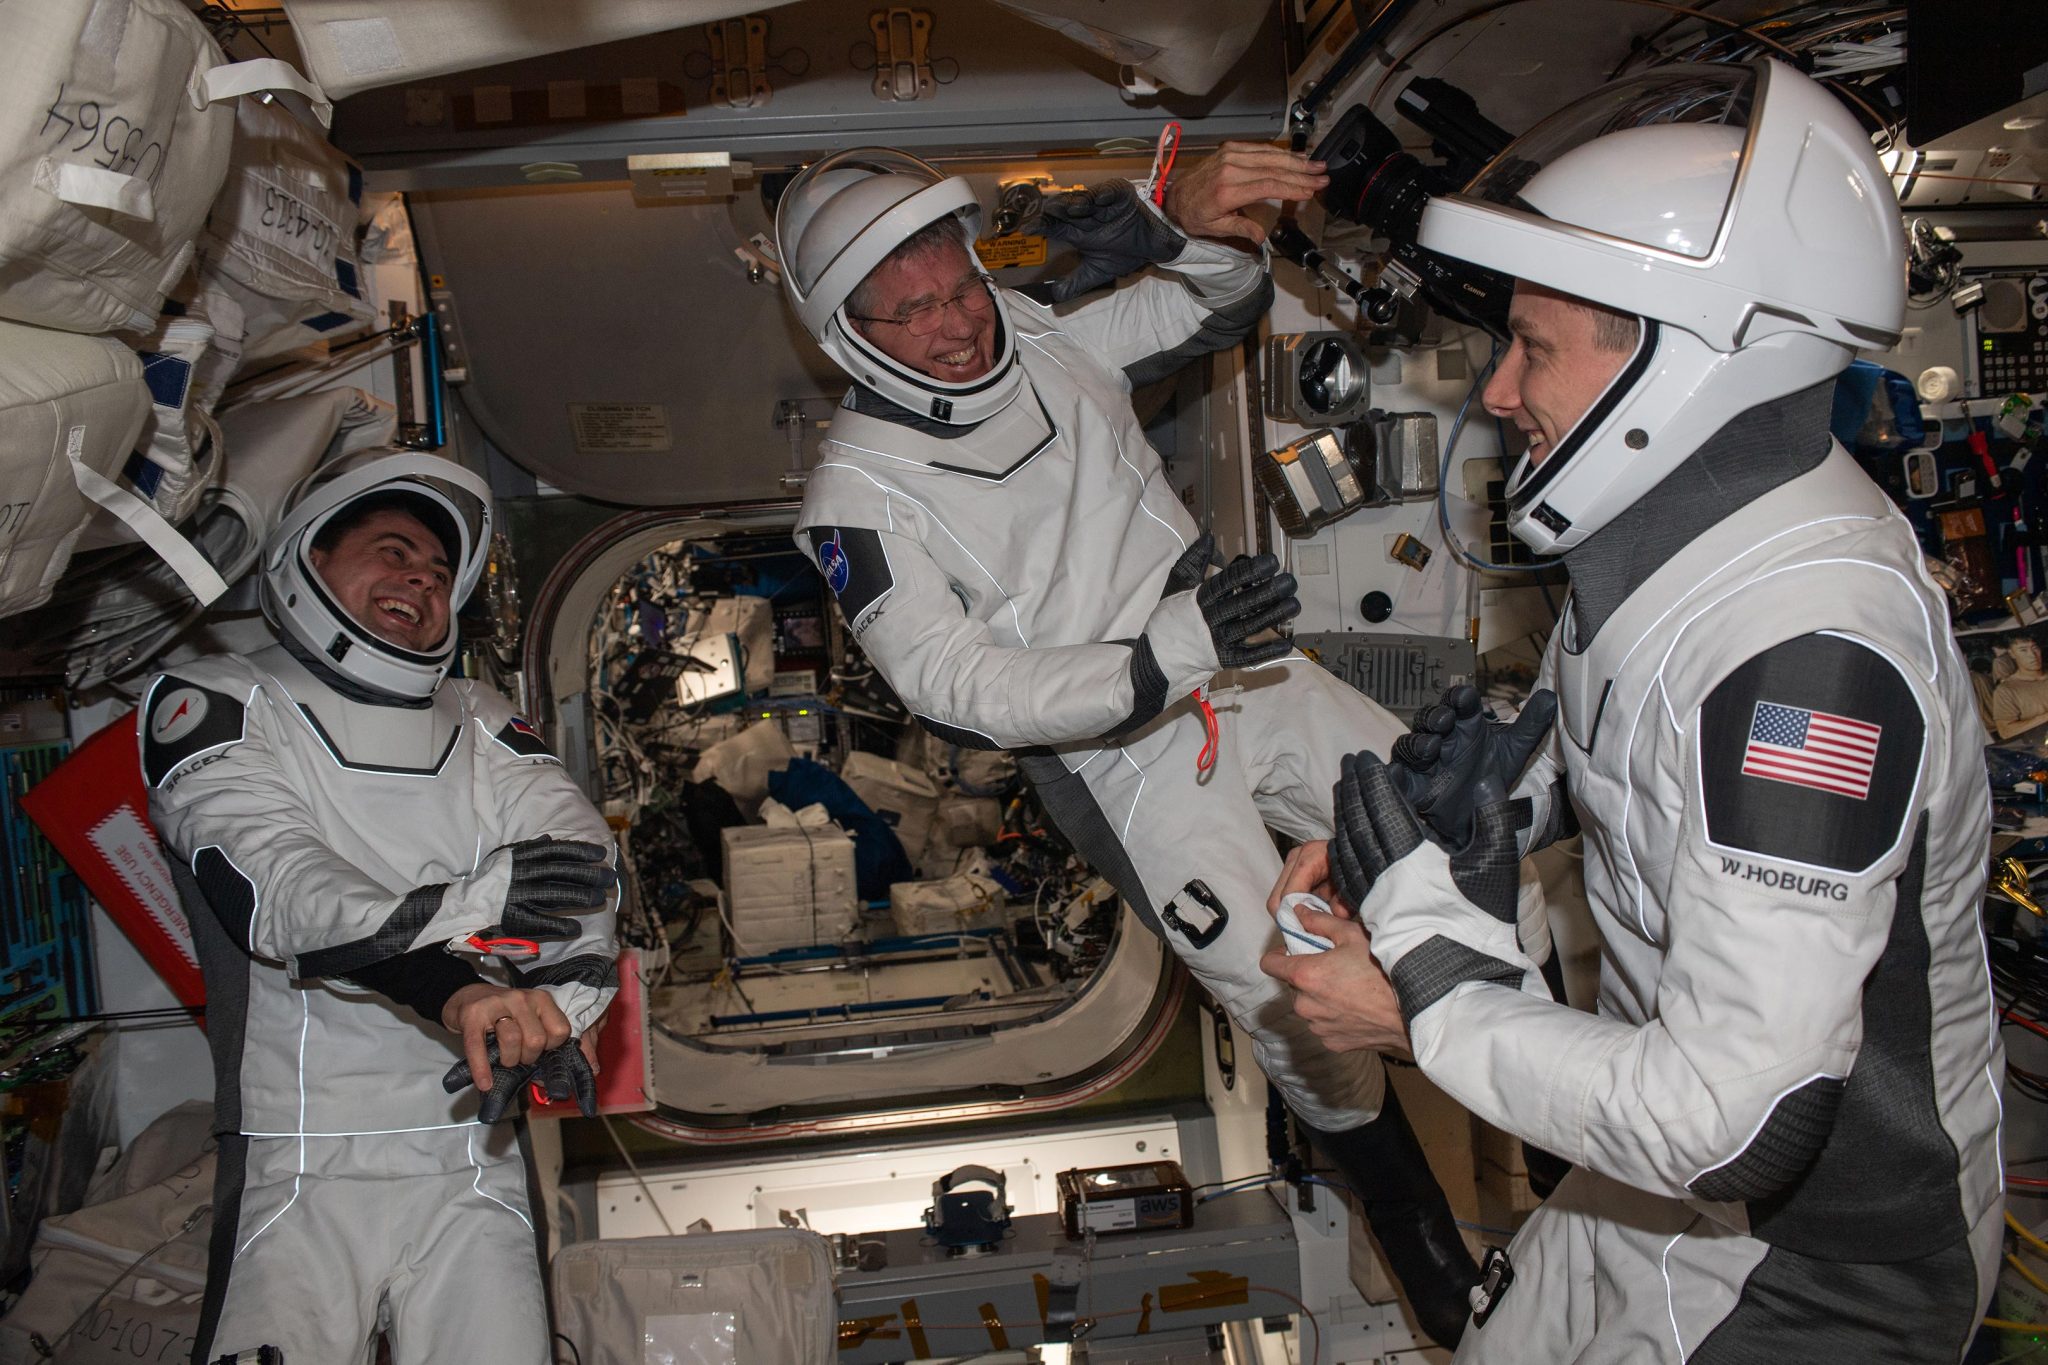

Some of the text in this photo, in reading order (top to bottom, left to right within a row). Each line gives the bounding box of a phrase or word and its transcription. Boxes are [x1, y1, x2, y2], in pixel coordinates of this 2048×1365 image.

[1463, 283, 1487, 298] Canon
[165, 743, 236, 794] SPACEX
[115, 843, 191, 939] EMERGENCY USE
[1720, 856, 1849, 901] W.HOBURG
[1141, 1196, 1178, 1213] aws
